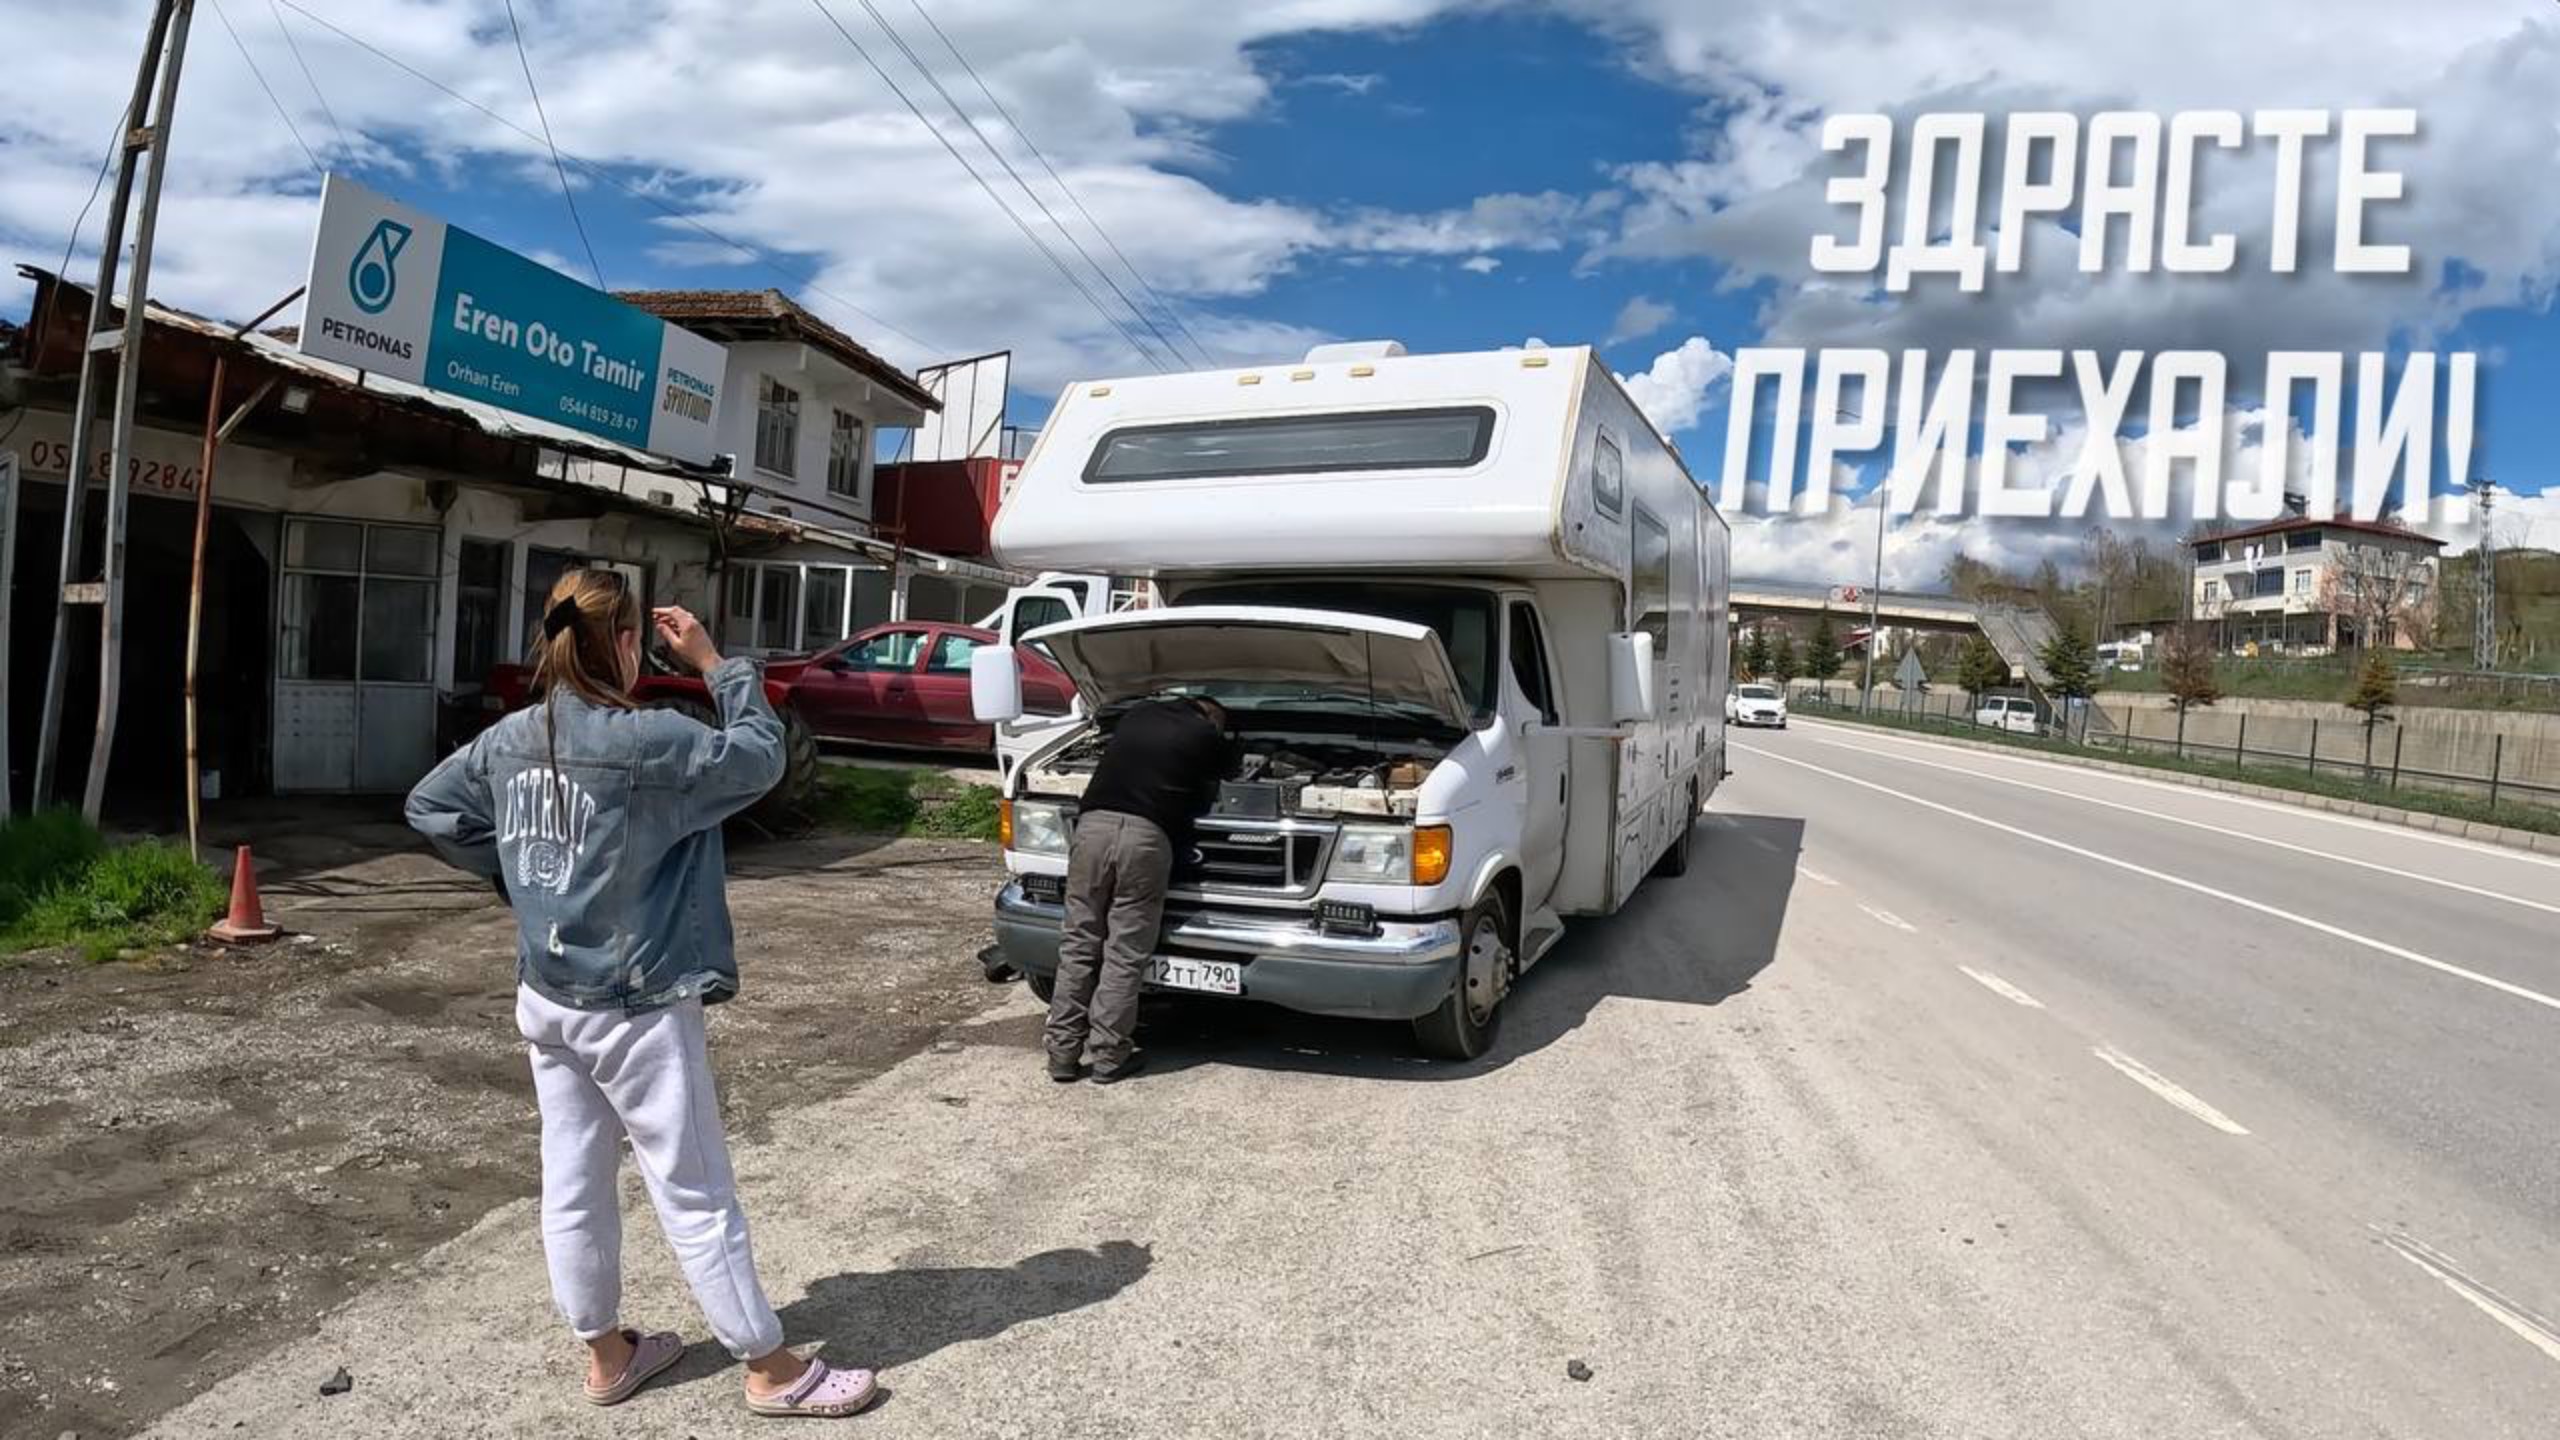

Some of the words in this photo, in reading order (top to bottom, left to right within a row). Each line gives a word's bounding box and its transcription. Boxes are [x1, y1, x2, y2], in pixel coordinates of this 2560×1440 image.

[321, 317, 413, 360] PETRONAS
[453, 292, 519, 348] Eren
[525, 320, 575, 367] Oto
[581, 339, 645, 392] Tamir
[447, 361, 489, 388] Orhan
[491, 374, 519, 397] Eren
[667, 367, 716, 397] PETRONAS
[559, 395, 588, 416] 0544
[589, 404, 610, 424] 819
[610, 411, 623, 429] 28
[625, 418, 639, 433] 47
[501, 767, 596, 855] DETROIT
[1202, 964, 1236, 984] 790
